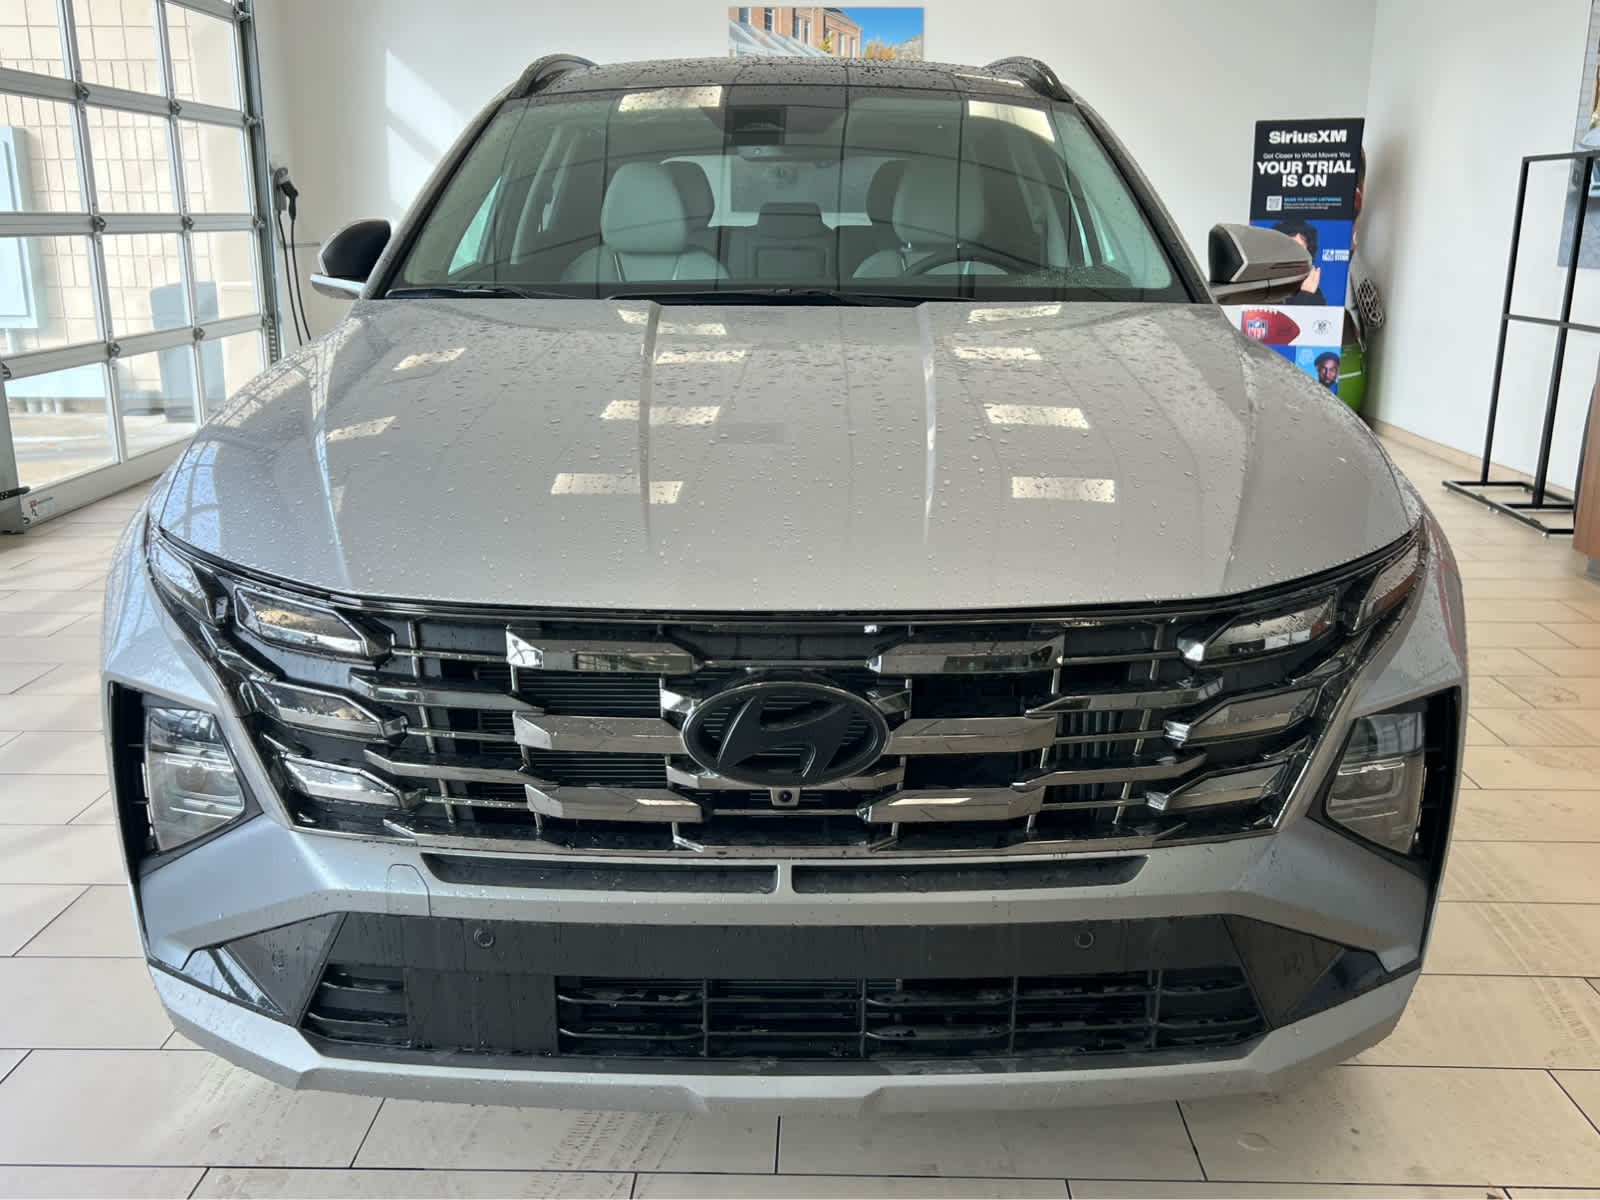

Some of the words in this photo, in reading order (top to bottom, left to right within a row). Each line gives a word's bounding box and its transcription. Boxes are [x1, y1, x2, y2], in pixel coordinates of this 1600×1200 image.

[1268, 129, 1348, 144] SiriusXM
[1256, 160, 1303, 175] YOUR
[1306, 159, 1356, 174] TRIAL
[1282, 174, 1298, 188] IS
[1301, 173, 1327, 187] ON
